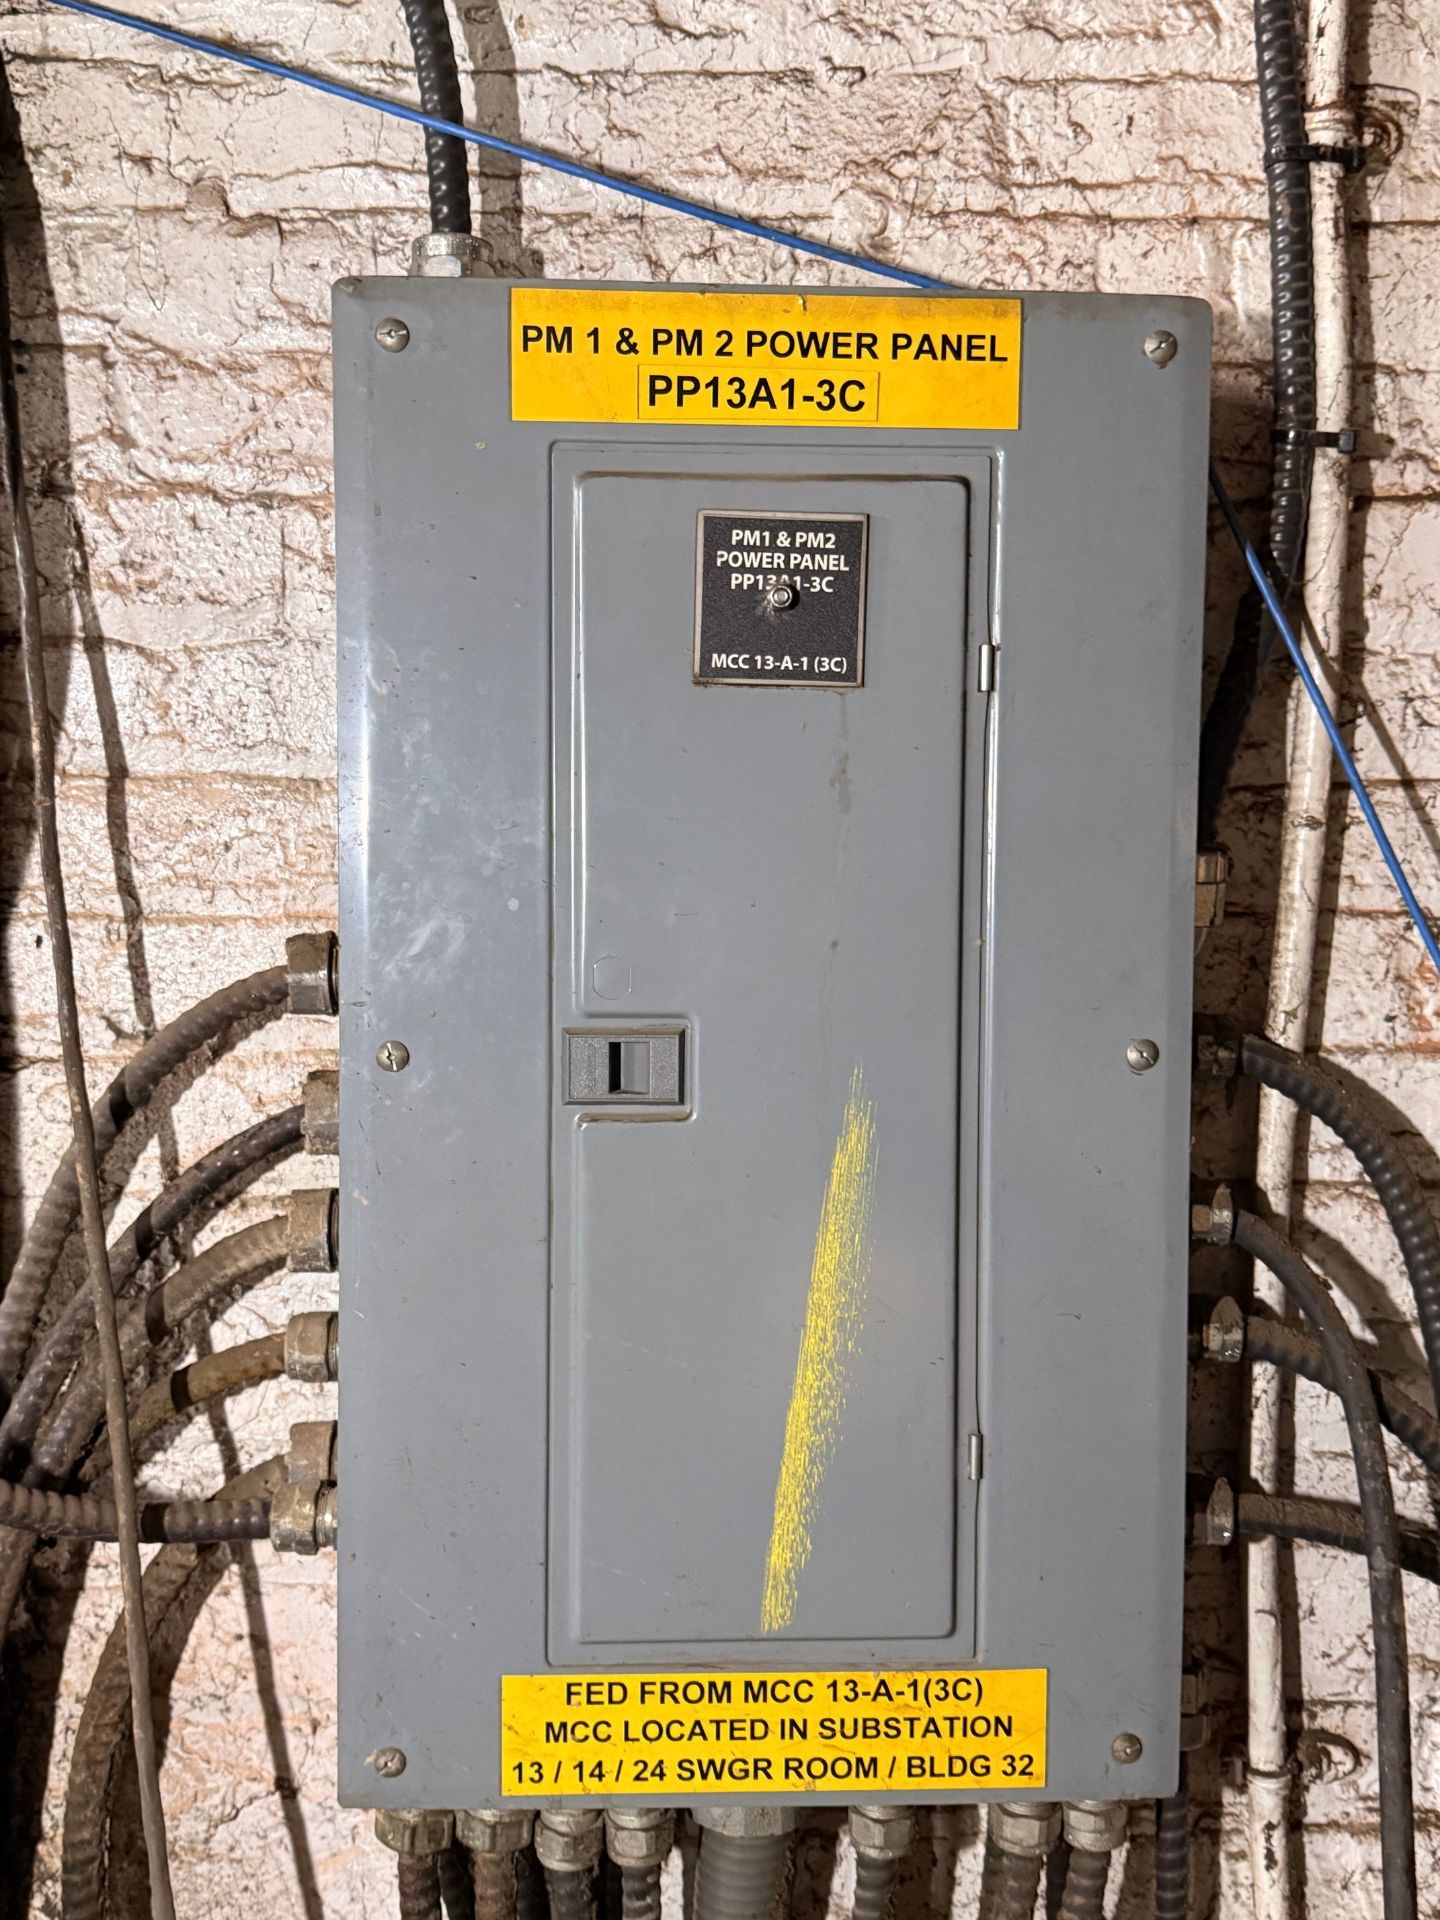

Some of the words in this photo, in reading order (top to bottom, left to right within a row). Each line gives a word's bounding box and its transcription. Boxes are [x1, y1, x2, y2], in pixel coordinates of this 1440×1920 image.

[522, 325, 573, 354] PM
[586, 327, 599, 354] 1
[615, 327, 640, 355] &
[652, 328, 703, 356] PM
[715, 329, 733, 357] 2
[746, 330, 879, 360] POWER
[891, 333, 1008, 362] PANEL
[649, 374, 866, 412] PP13A1-3C
[731, 529, 770, 547] PM1
[776, 530, 792, 548] &
[795, 531, 836, 549] PM2
[716, 550, 786, 569] POWER
[789, 552, 850, 572] PANEL
[711, 652, 750, 670] MCC
[754, 654, 808, 671] 13-A-1
[813, 656, 847, 674] (3C)
[566, 1681, 628, 1706] FED
[640, 1680, 732, 1705] FROM
[744, 1679, 814, 1703] MCC
[827, 1677, 983, 1708] 13-A-1(3C)
[545, 1720, 612, 1743] MCC
[624, 1718, 769, 1742] LOCATED
[780, 1718, 808, 1741] IN
[818, 1715, 1012, 1740] SUBSTATION
[512, 1761, 544, 1784] 13
[554, 1761, 562, 1783] /
[573, 1760, 606, 1783] 14
[615, 1759, 623, 1782] /
[633, 1759, 667, 1781] 24
[677, 1758, 773, 1781] SWGR
[784, 1756, 878, 1780] ROOM
[888, 1756, 897, 1778] /
[907, 1754, 991, 1778] BLDG
[1001, 1754, 1034, 1777] 32
